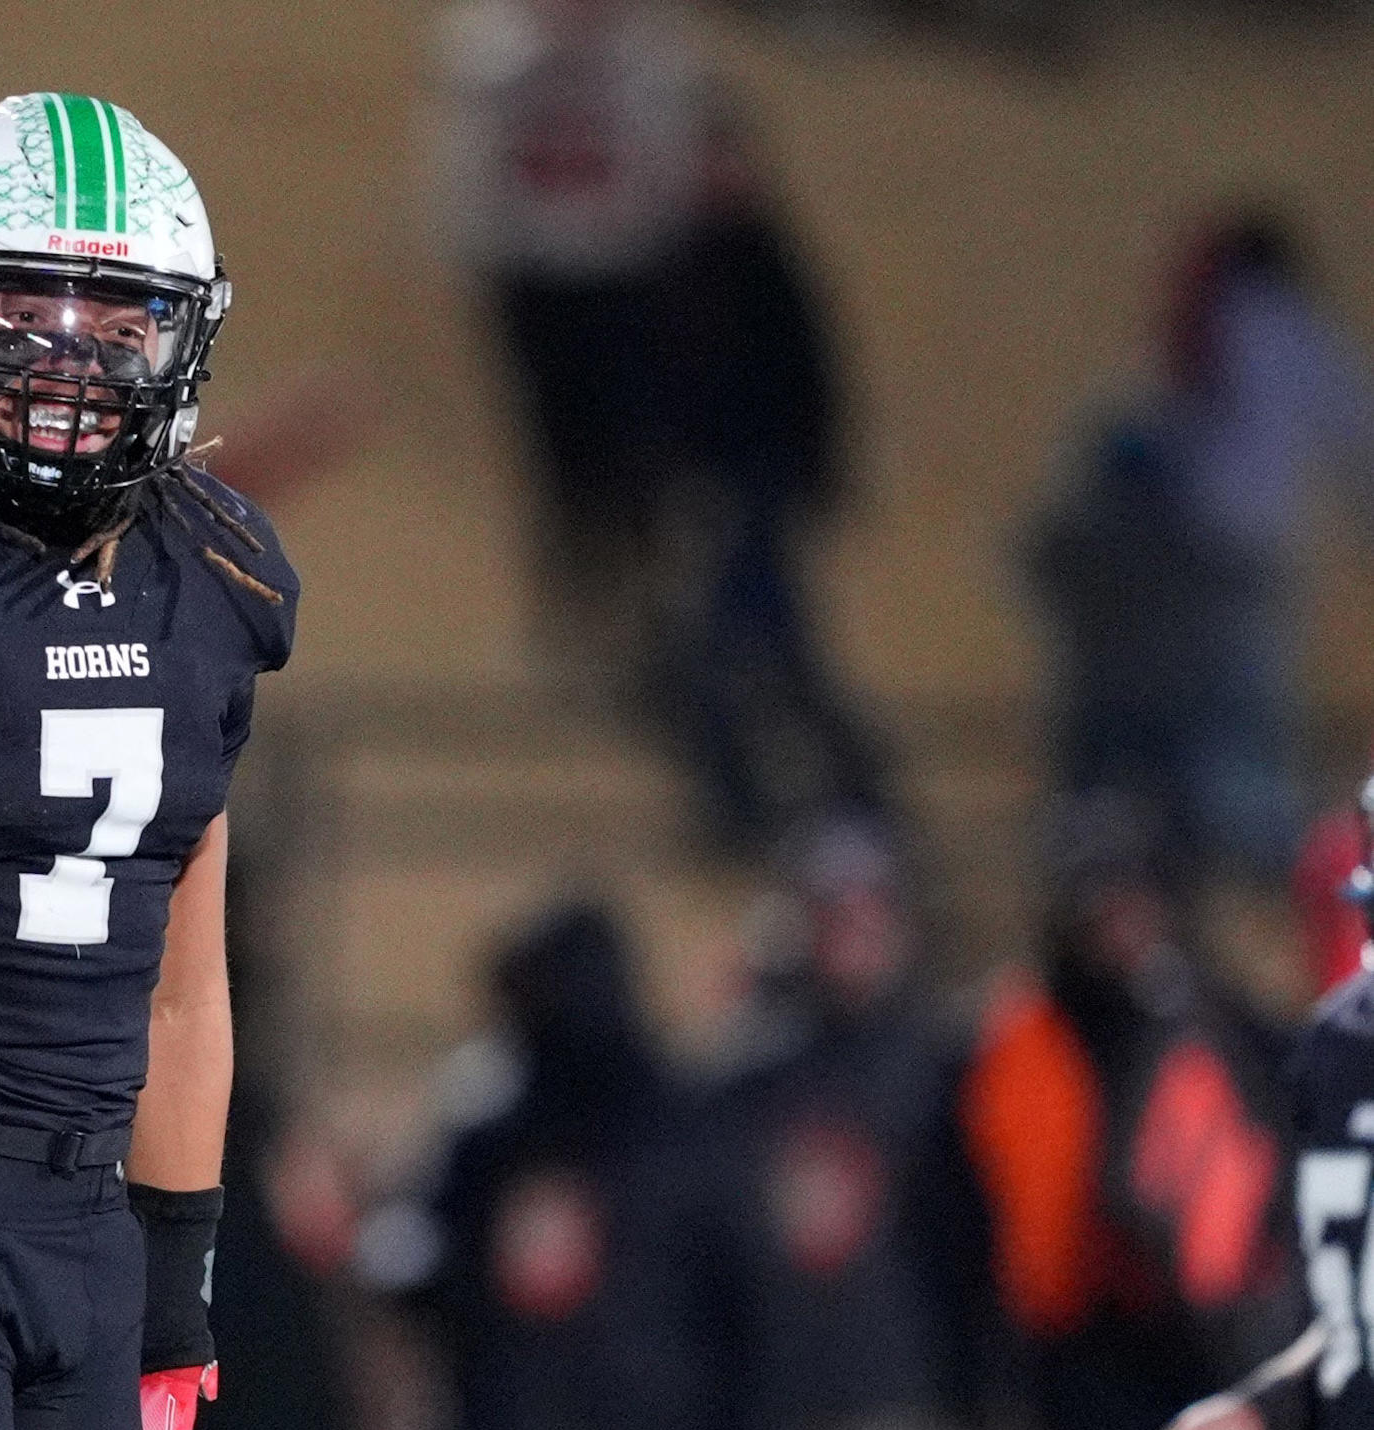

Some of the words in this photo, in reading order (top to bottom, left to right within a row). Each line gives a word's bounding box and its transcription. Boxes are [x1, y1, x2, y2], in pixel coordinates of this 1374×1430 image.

[47, 234, 128, 257] Riddell
[45, 643, 150, 679] HORNS
[16, 708, 164, 943] 7
[1297, 1151, 1374, 1397] 5
